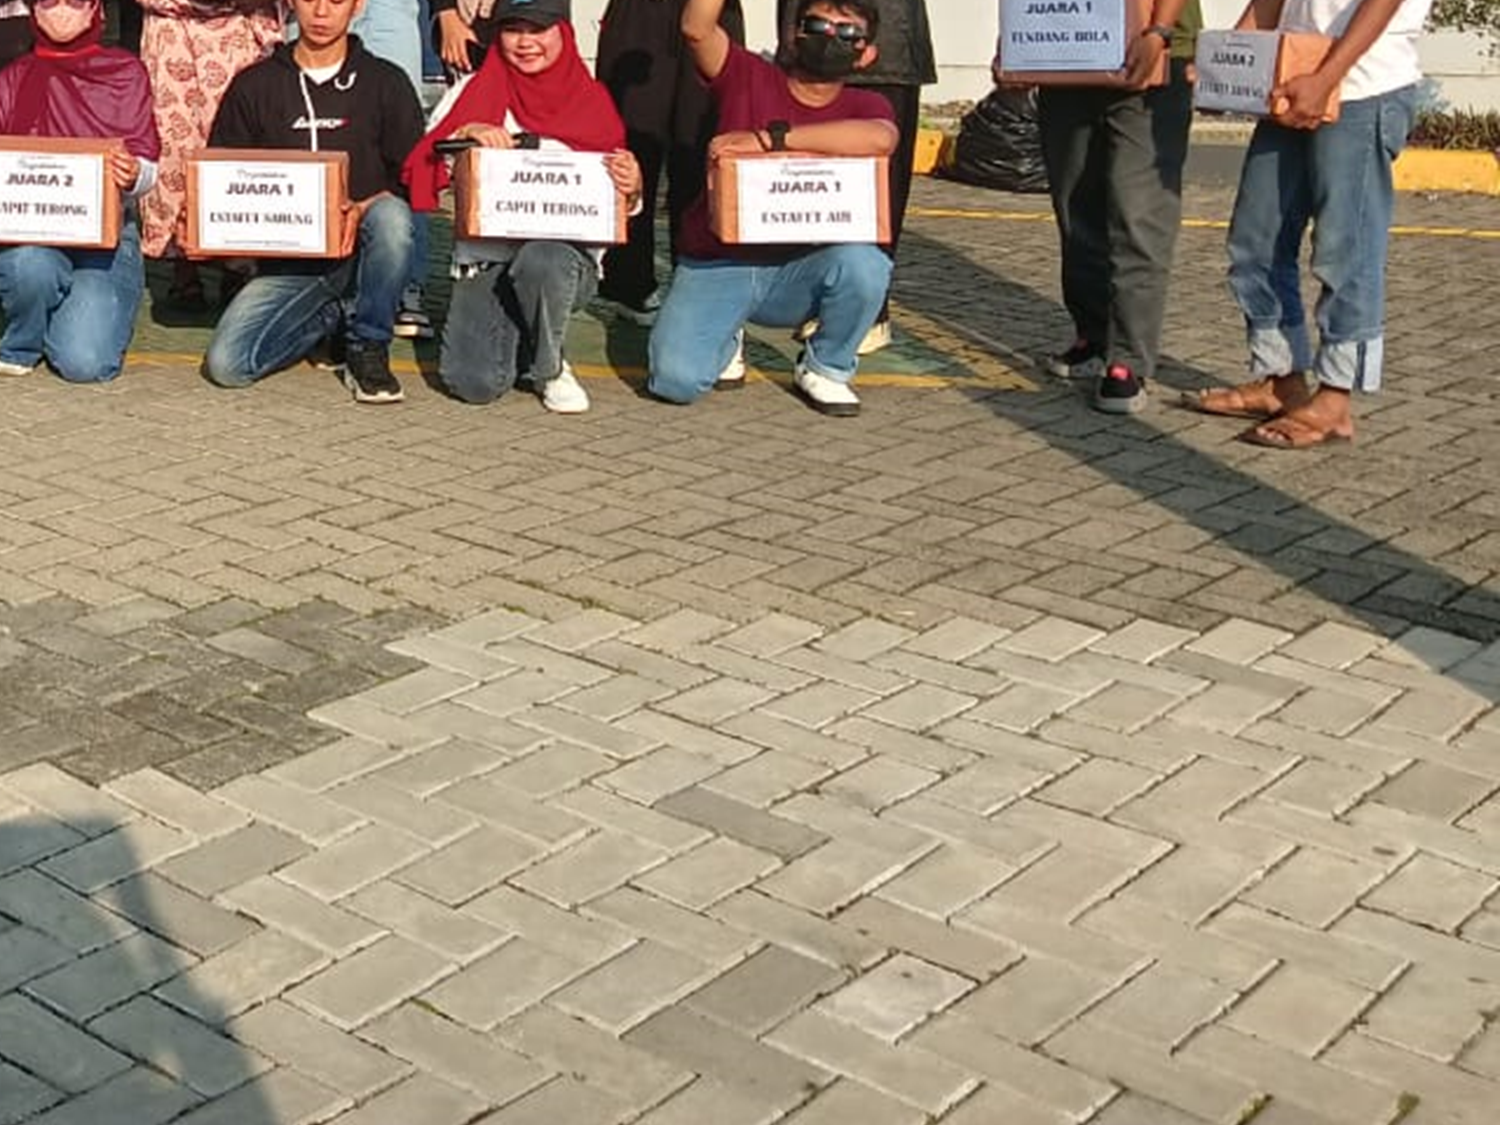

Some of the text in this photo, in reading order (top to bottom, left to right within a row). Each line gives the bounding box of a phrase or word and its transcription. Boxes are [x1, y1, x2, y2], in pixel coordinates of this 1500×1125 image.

[1025, 1, 1092, 14] JUARA 1
[1011, 30, 1110, 44] TENDANG BOLA
[1210, 52, 1255, 67] JUARA 2
[6, 173, 74, 186] JUARA 2
[510, 171, 582, 185] JUARA 1
[226, 183, 294, 196] JUARA 1
[768, 181, 841, 193] JUARA 1
[35, 202, 88, 216] TERONG
[496, 200, 599, 216] CAPIT TERONG
[761, 211, 852, 223] ESTAFET AIR
